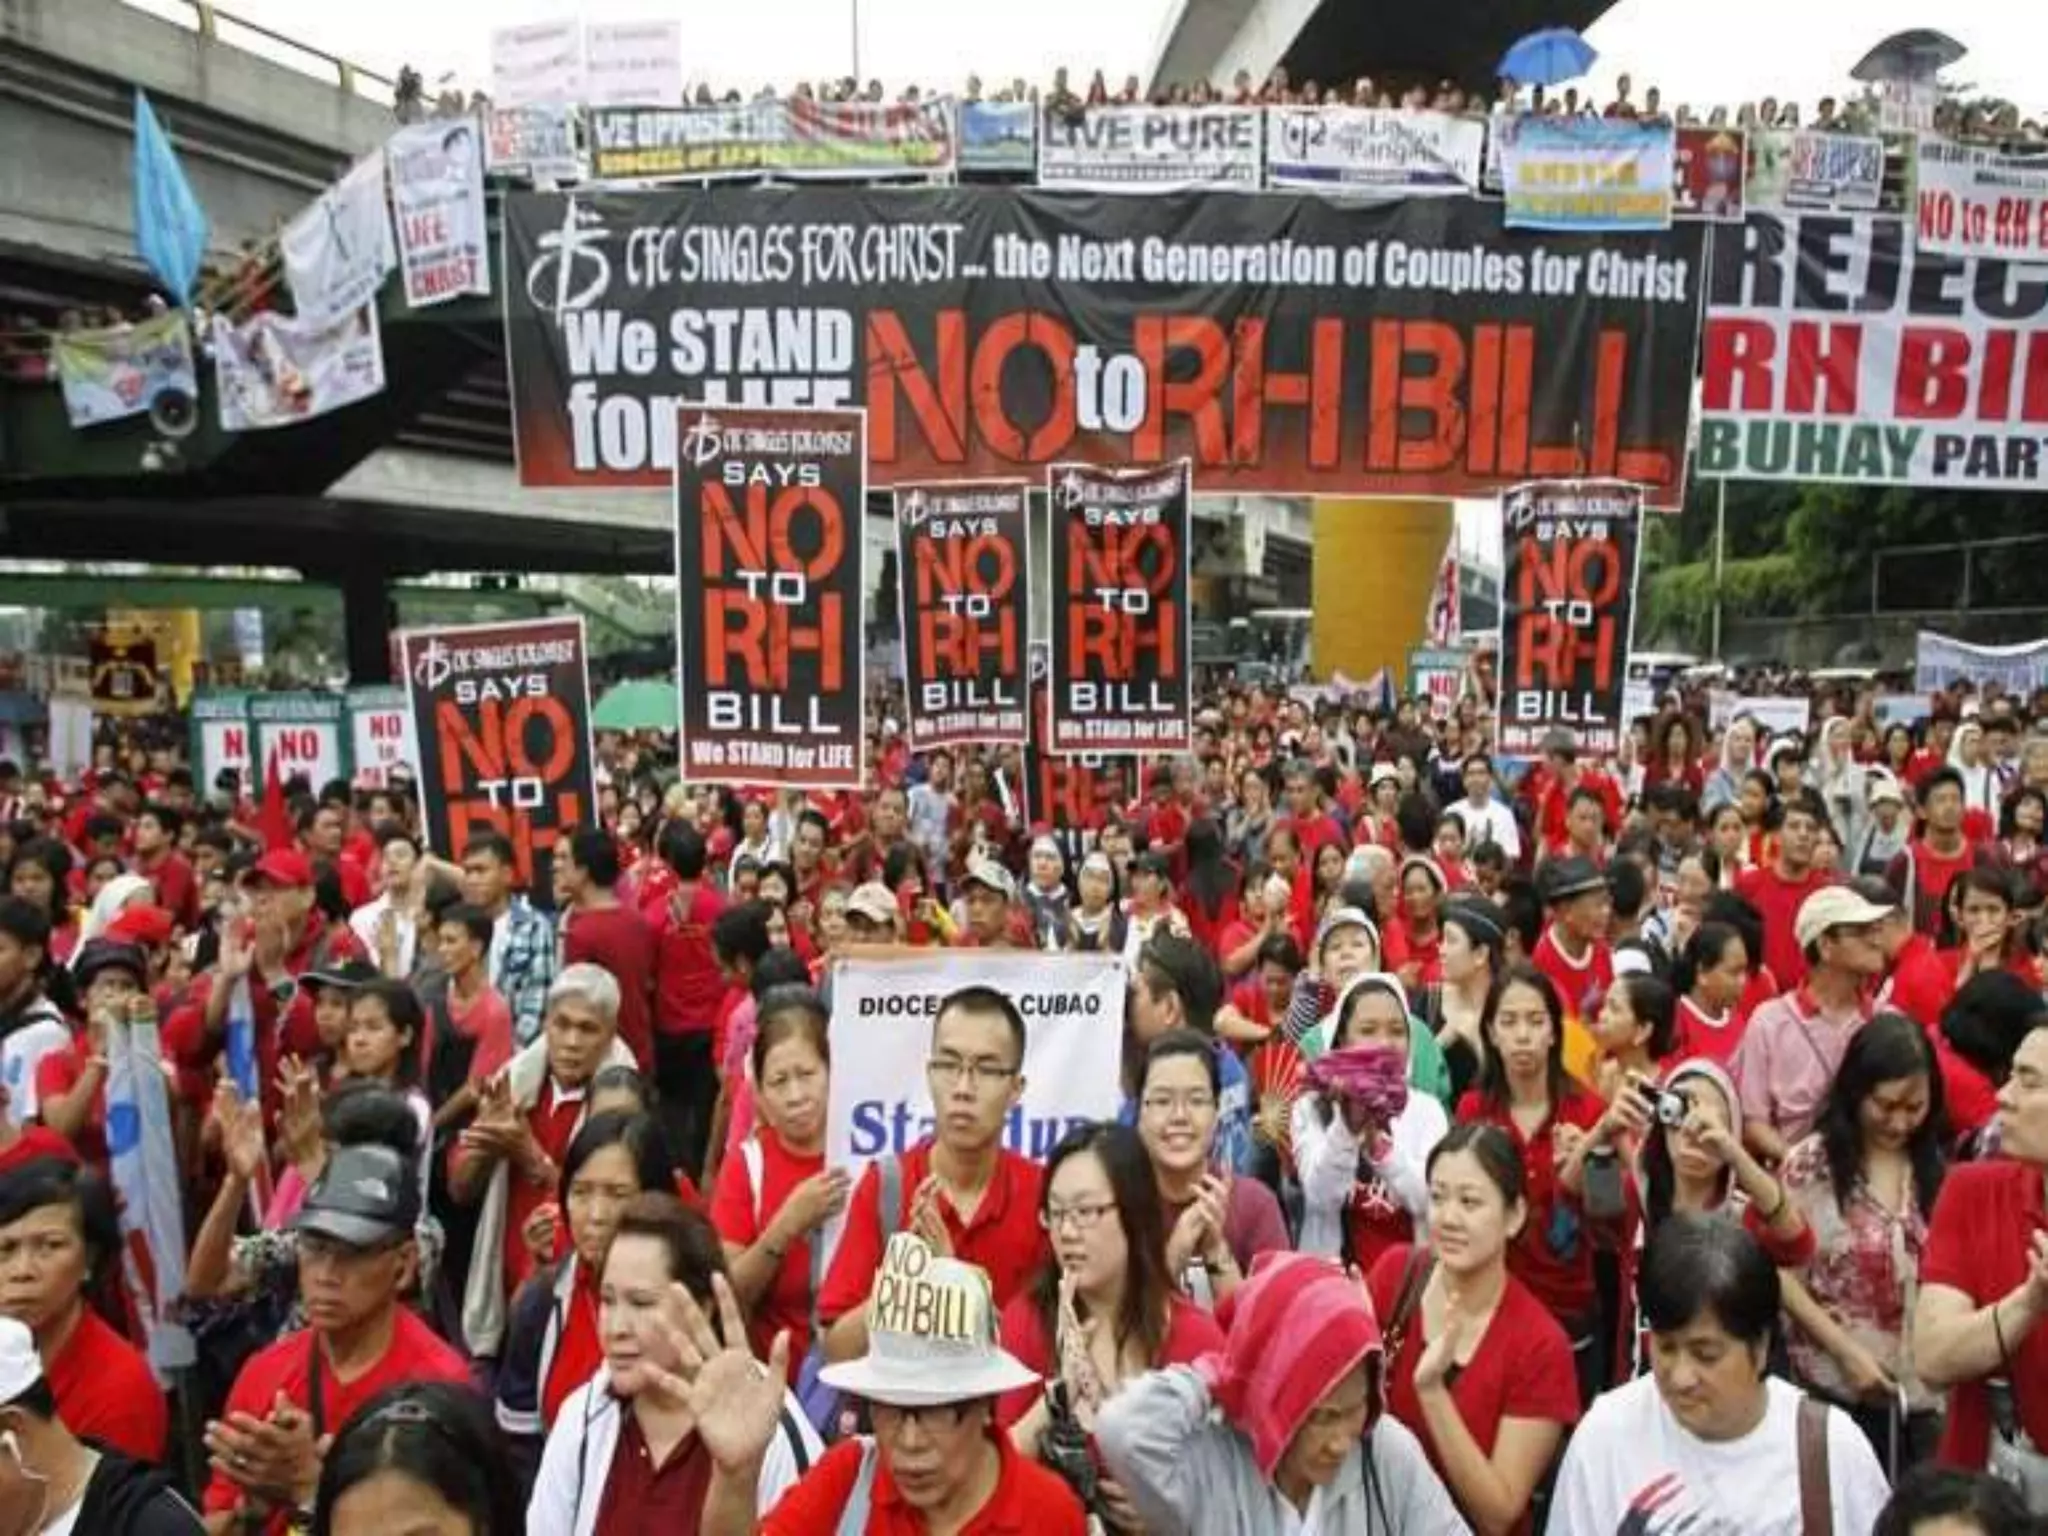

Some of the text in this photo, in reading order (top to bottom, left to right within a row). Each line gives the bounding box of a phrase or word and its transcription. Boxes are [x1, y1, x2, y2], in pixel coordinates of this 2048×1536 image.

[1044, 114, 1133, 149] LIVE
[1144, 114, 1252, 150] PURE
[1920, 191, 1954, 241] NO
[1961, 197, 1987, 244] to
[1995, 197, 2030, 248] RH
[626, 226, 676, 288] CFC
[681, 224, 796, 283] SINGLES
[801, 223, 860, 286] FOR
[993, 233, 1049, 278] the
[1058, 234, 1135, 282] Next
[1142, 236, 1336, 285] Generation
[1343, 239, 1380, 287] of
[1384, 241, 1524, 295] Couples
[1530, 247, 1582, 294] for
[1587, 249, 1688, 302] Christ
[563, 309, 853, 375] We STAND
[1702, 318, 1863, 416] RH
[867, 306, 1674, 486] NO to RH BILL
[1699, 418, 1923, 478] BUHAY
[722, 460, 821, 487] SAYS
[701, 481, 846, 582] NO
[930, 517, 999, 539] SAYS
[1084, 505, 1160, 526] SAYS
[913, 535, 1017, 607] NO
[1066, 519, 1176, 596] NO
[1518, 536, 1621, 608] NO
[736, 569, 807, 605] TO
[942, 594, 991, 617] TO
[1096, 587, 1150, 615] TO
[1543, 600, 1593, 626] TO
[704, 587, 843, 691] RH
[918, 605, 1017, 681] RH
[1068, 600, 1177, 679] RH
[1516, 611, 1615, 690] RH
[455, 674, 549, 705] SAYS
[922, 678, 1016, 712] BILL
[1069, 681, 1176, 713] BILL
[1516, 689, 1607, 722] BILL
[369, 715, 401, 739] NO
[707, 691, 841, 734] BILL
[279, 728, 320, 761] NO
[435, 695, 575, 794] NO
[691, 741, 724, 766] We
[728, 741, 784, 767] STAND
[818, 744, 855, 769] LIFE
[478, 776, 544, 812] TO
[858, 994, 938, 1016] DIOCE
[1020, 993, 1100, 1016] CUBAO
[889, 1239, 927, 1278] NO
[873, 1276, 972, 1338] RH BILL
